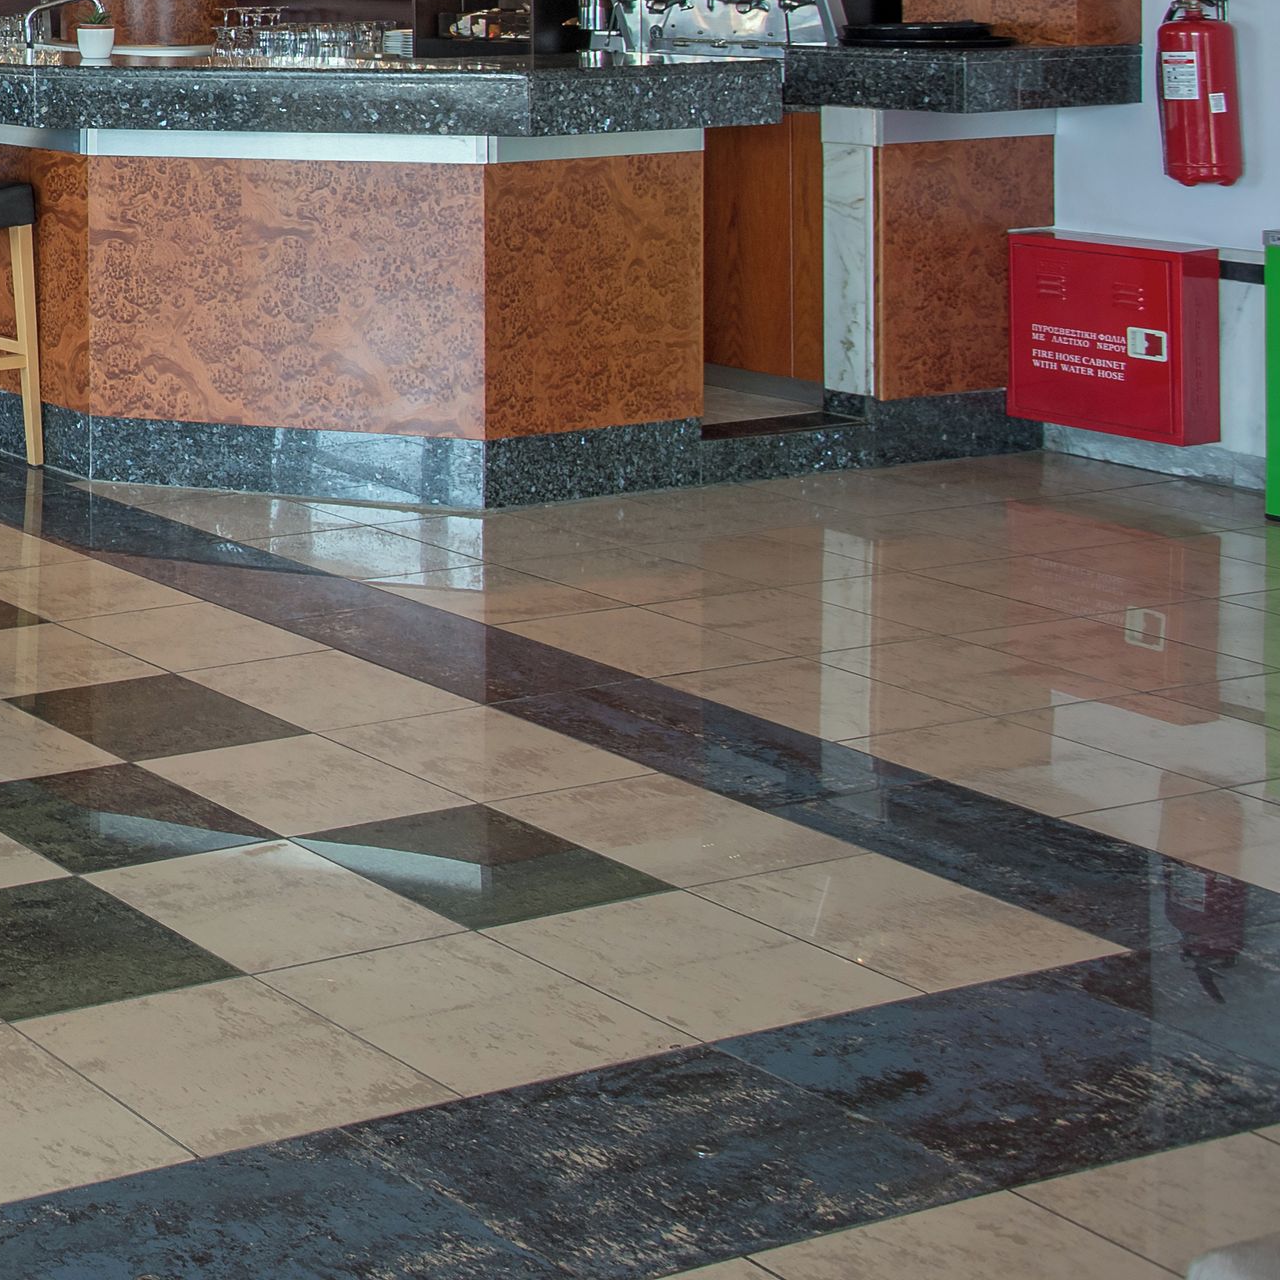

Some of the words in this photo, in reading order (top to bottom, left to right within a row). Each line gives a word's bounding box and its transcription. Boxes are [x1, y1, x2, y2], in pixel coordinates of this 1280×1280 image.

[1051, 335, 1090, 348] ΛΑΣΤΙΧΟ
[1096, 342, 1126, 353] ΝΕΡΟΥ
[1098, 333, 1126, 344] ΦΩΛΙΑ
[1032, 348, 1054, 358] FIRE
[1056, 353, 1081, 363] HOSE
[1082, 357, 1126, 370] CABINET
[1032, 359, 1057, 370] WITH
[1060, 363, 1094, 376] WATER
[1097, 369, 1125, 381] HOSE
